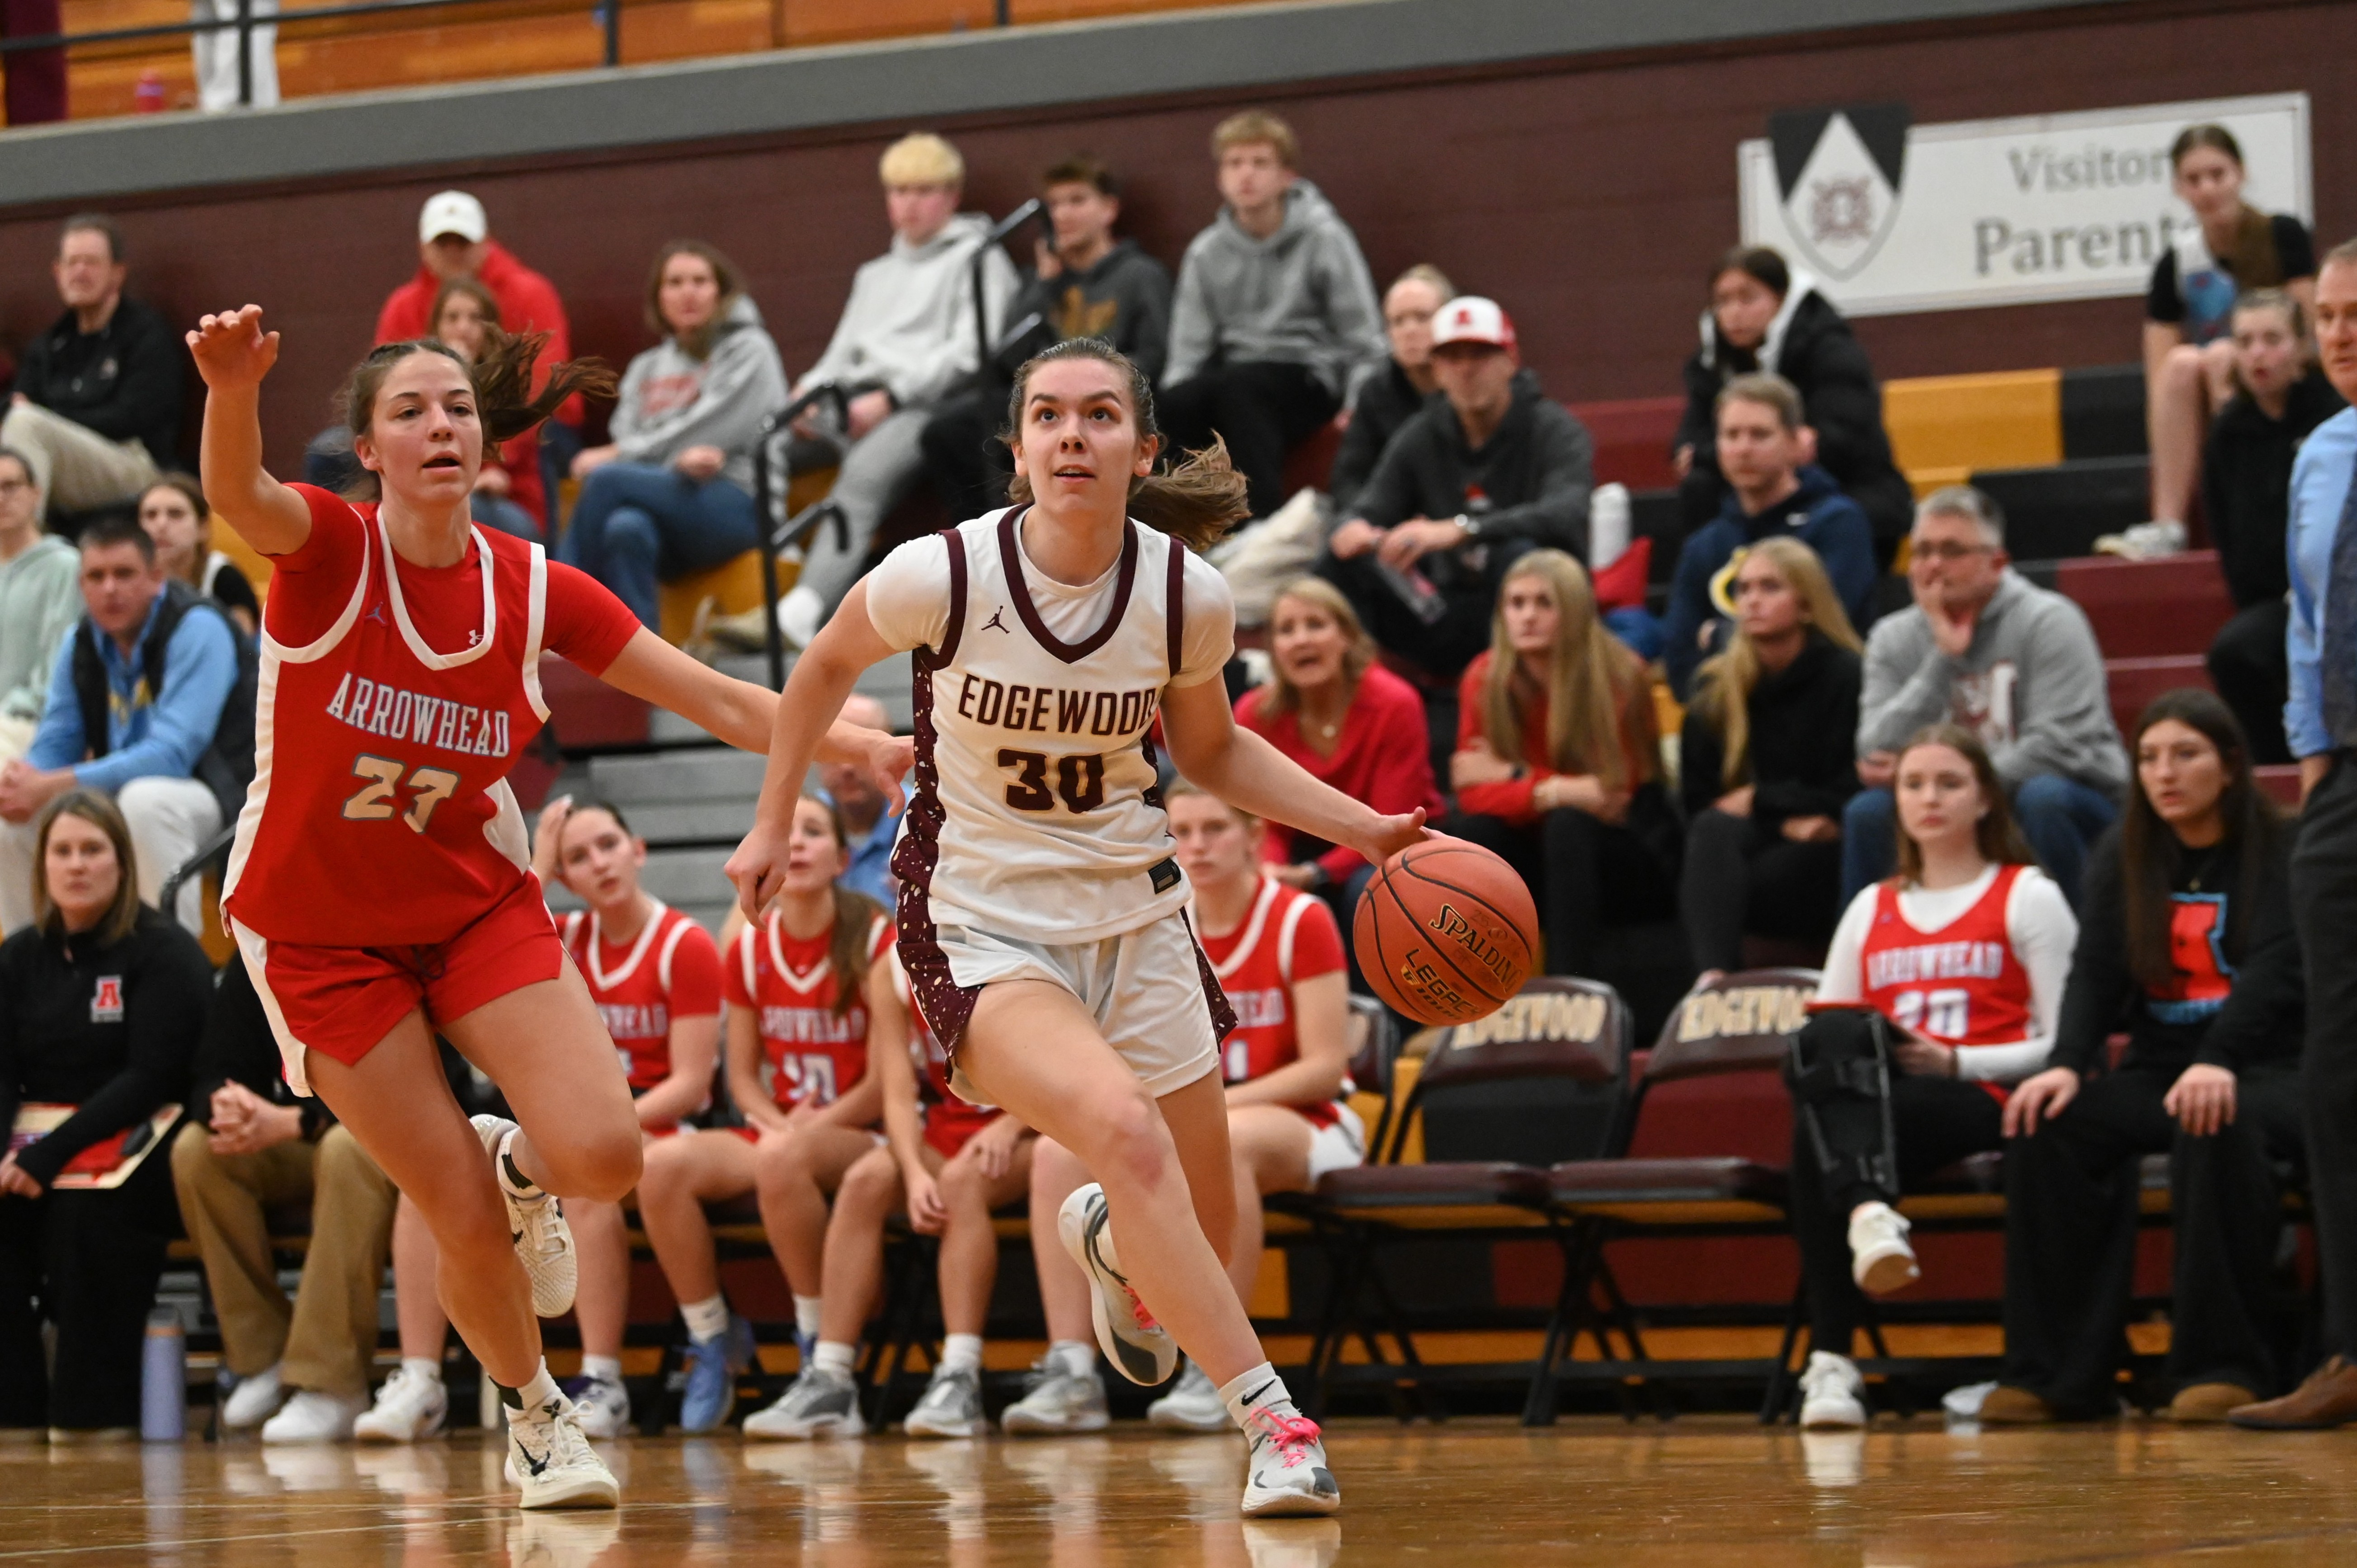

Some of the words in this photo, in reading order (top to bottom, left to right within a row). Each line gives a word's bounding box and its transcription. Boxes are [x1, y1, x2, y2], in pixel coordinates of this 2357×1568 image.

[1973, 212, 2200, 276] Parent
[325, 671, 509, 758] ARROWHEAD
[957, 673, 1156, 736] EDGEWOOD
[341, 752, 461, 834] 23
[996, 747, 1105, 815] 30
[1428, 903, 1523, 993] SPALDING
